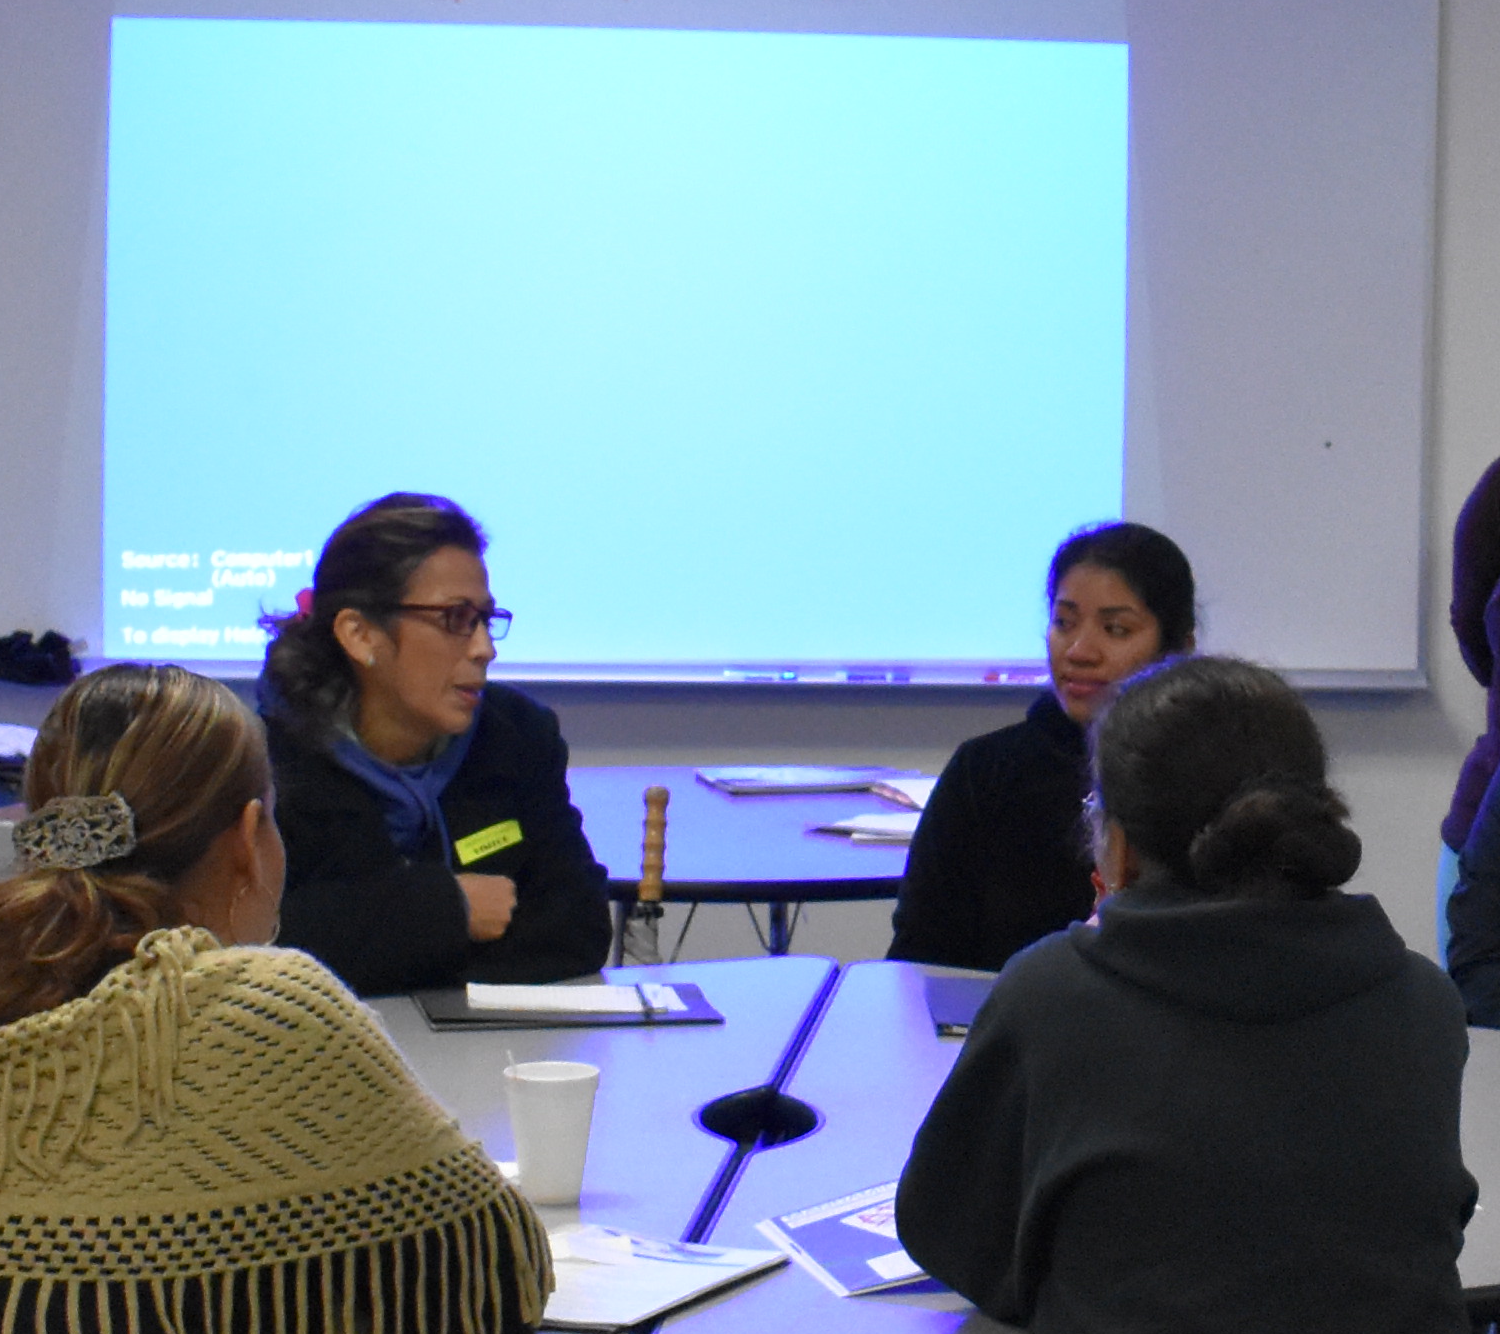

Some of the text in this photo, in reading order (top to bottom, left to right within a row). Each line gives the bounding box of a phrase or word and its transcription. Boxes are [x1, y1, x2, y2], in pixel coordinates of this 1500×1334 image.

[121, 550, 200, 569] Source:
[211, 567, 276, 588] (Auto)
[121, 587, 214, 609] No Signal
[121, 626, 148, 645] To
[150, 626, 220, 646] display
